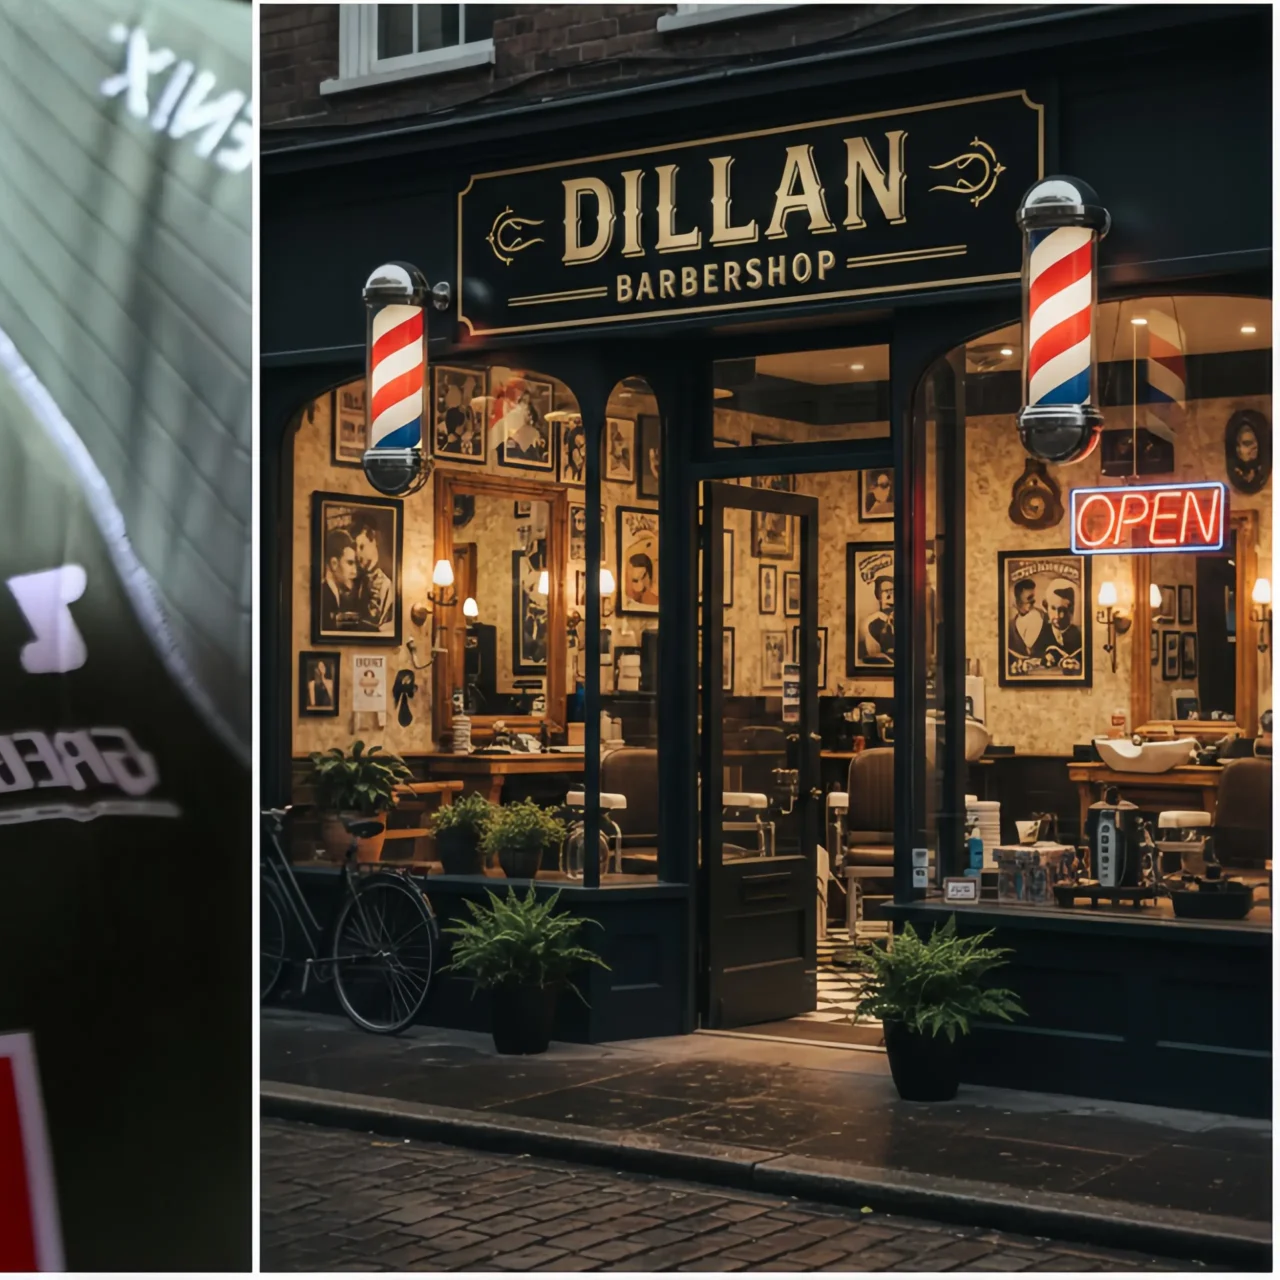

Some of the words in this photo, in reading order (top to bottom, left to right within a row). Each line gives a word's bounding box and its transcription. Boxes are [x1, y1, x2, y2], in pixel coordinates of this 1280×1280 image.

[561, 130, 908, 265] DILLAN
[617, 250, 836, 303] BARBERSHOP
[1077, 489, 1219, 546] OPEN
